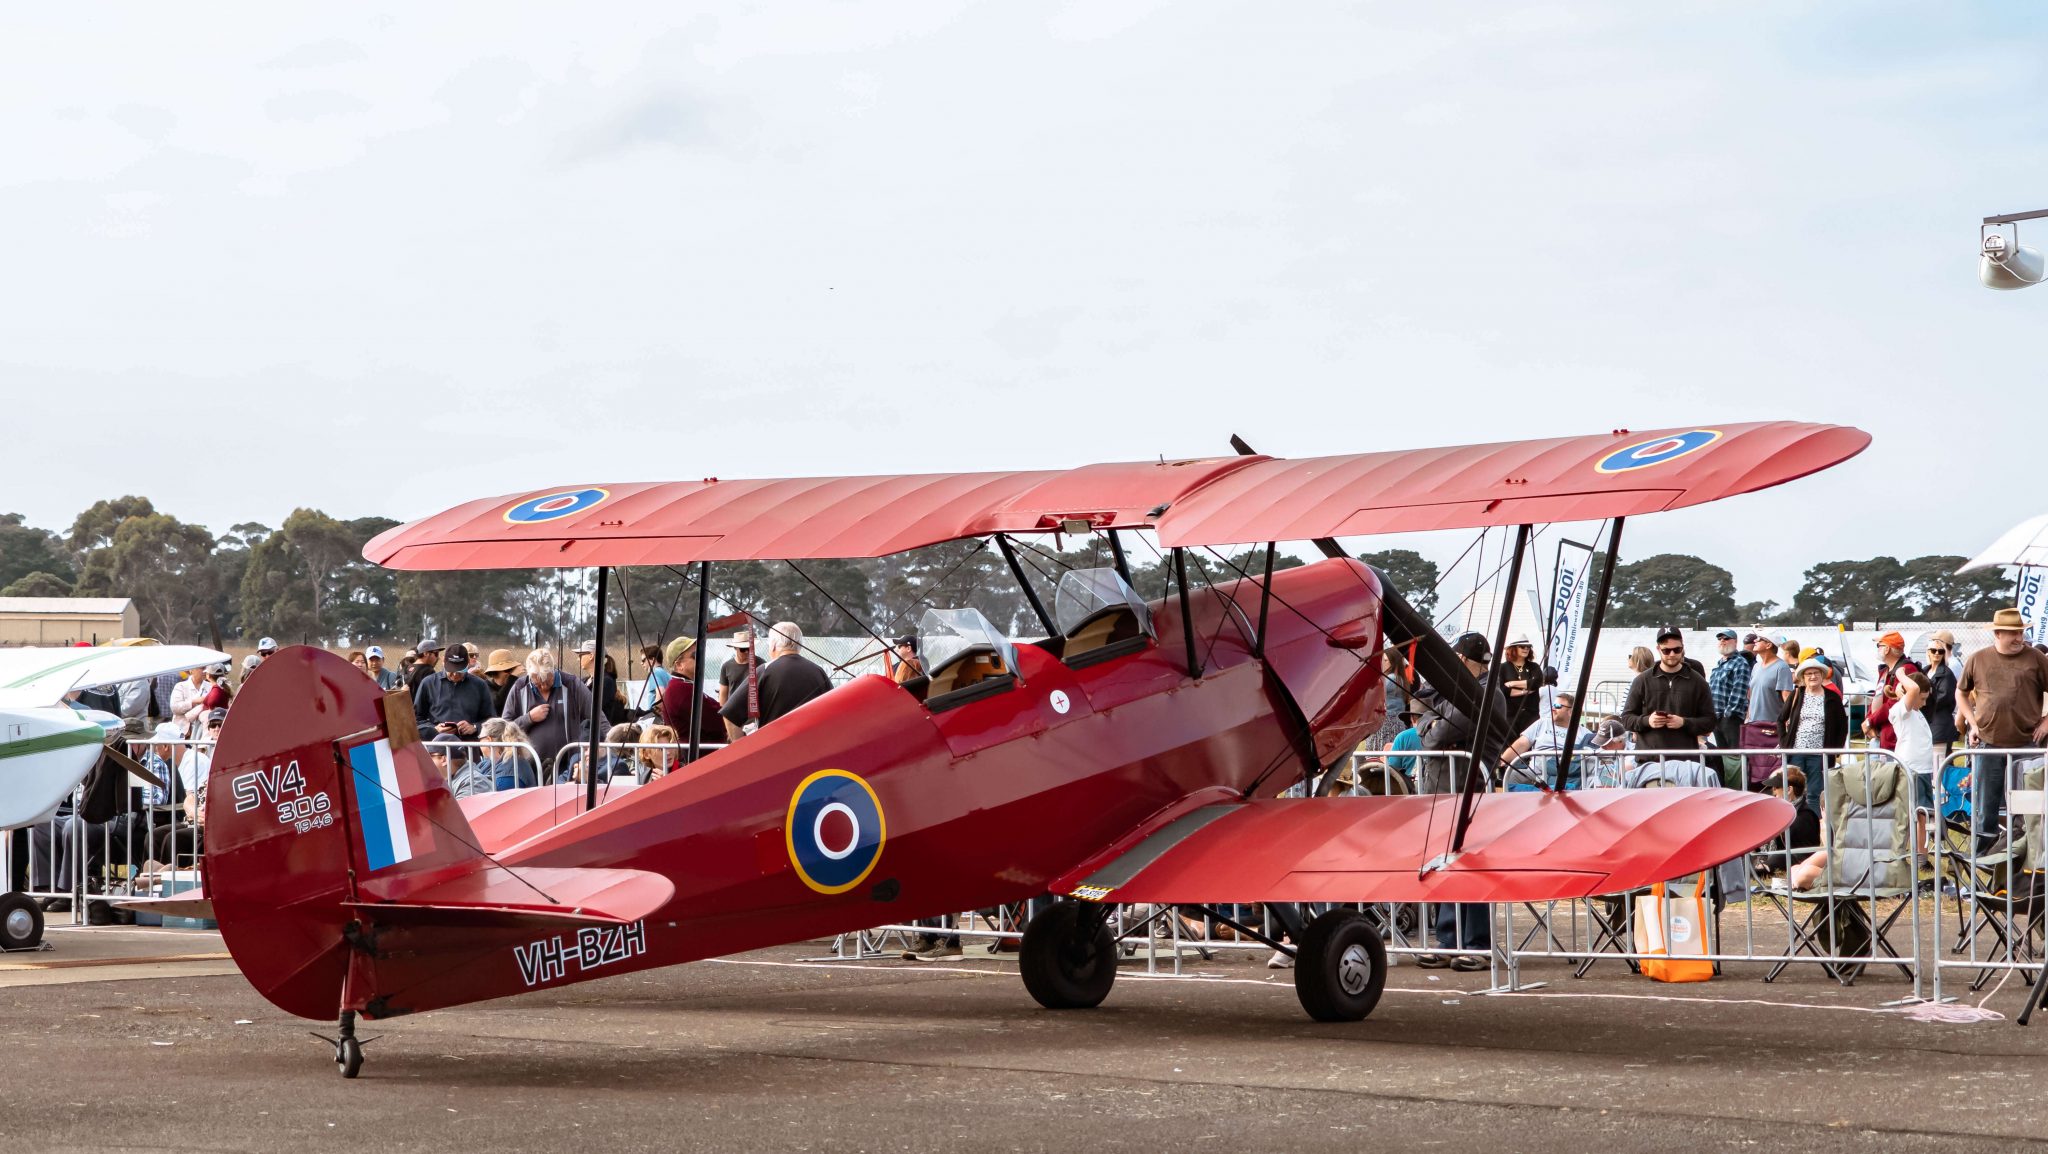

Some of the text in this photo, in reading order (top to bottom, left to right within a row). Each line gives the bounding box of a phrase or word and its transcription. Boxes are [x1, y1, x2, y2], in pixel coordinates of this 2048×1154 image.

[1556, 568, 1574, 611] POOL
[2021, 574, 2042, 618] POOL
[232, 760, 307, 813] SV4
[277, 792, 331, 823] 306
[295, 813, 333, 834] 1946
[513, 919, 646, 986] VH-BZH
